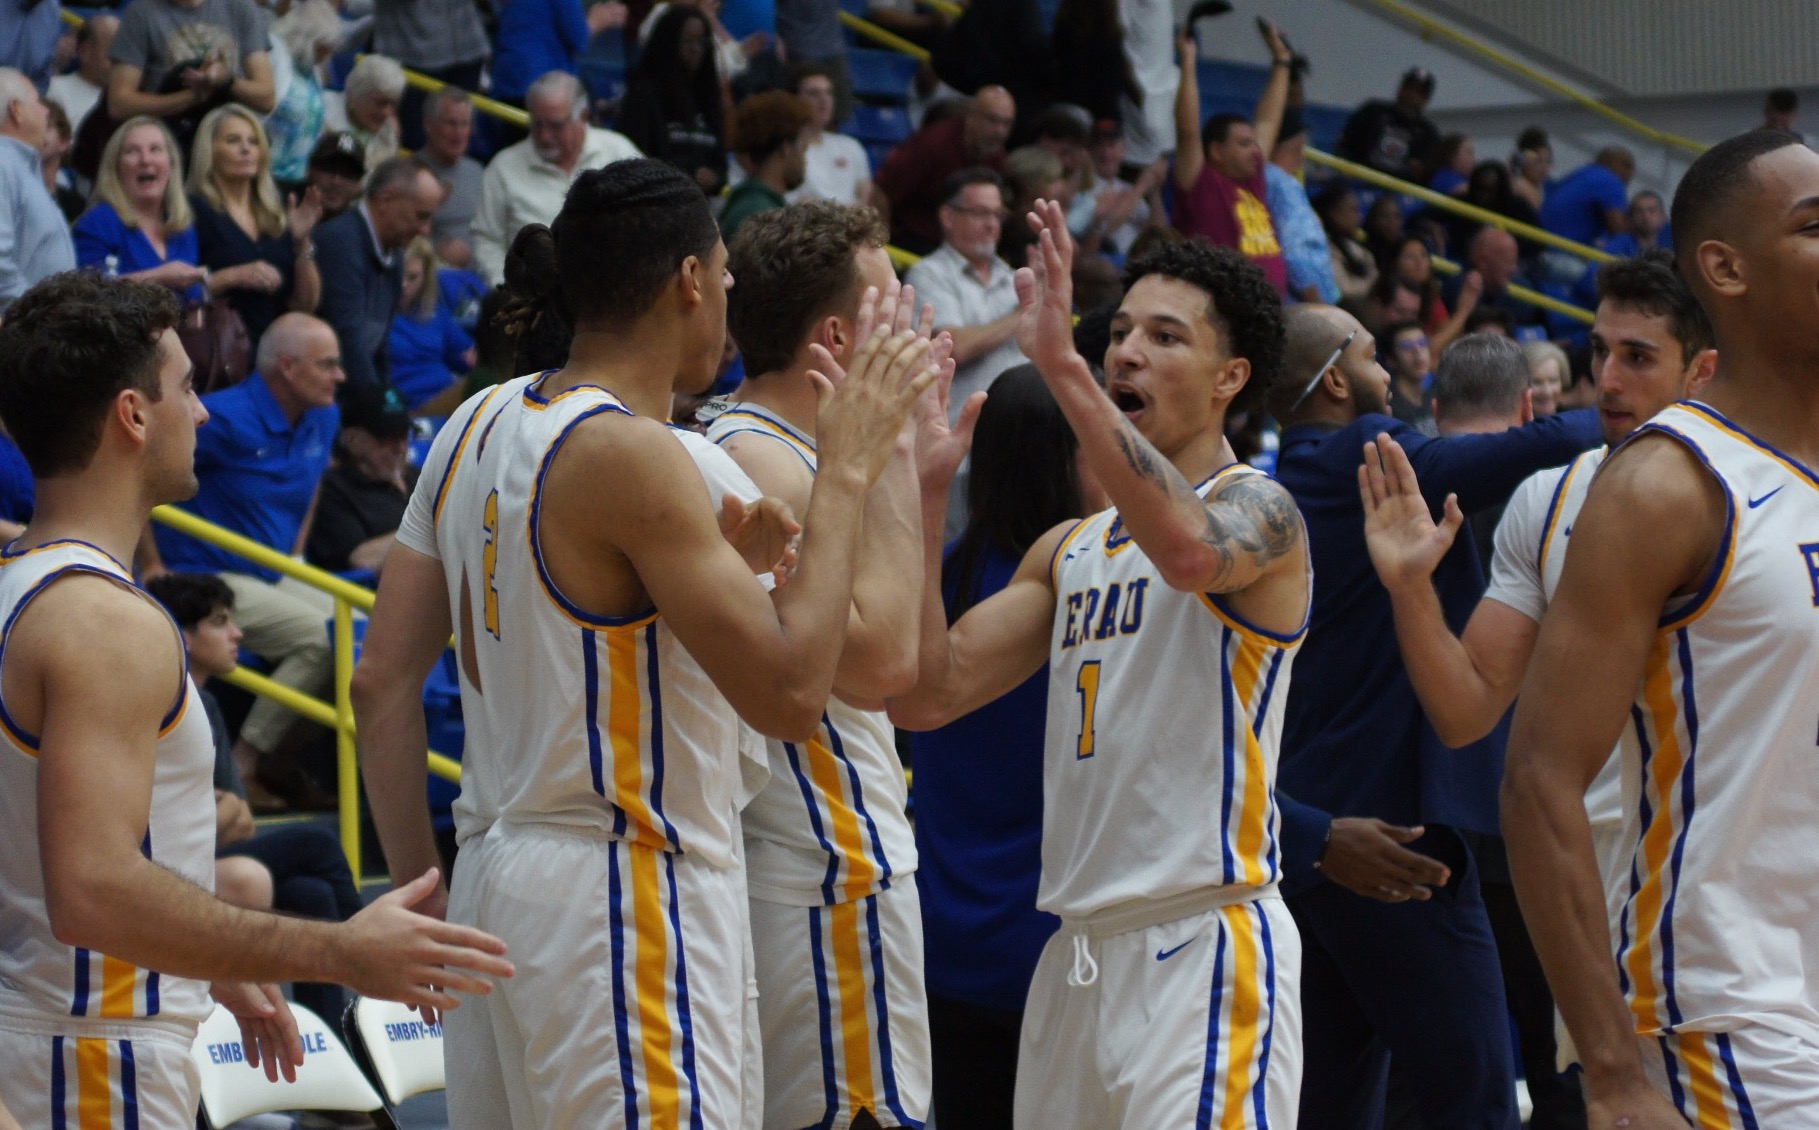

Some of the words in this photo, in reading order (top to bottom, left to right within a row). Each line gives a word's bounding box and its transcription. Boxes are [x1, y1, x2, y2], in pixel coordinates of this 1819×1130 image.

[1062, 577, 1149, 650] ERAU
[1076, 660, 1101, 761] 1
[385, 1020, 443, 1042] EMBRY-RI
